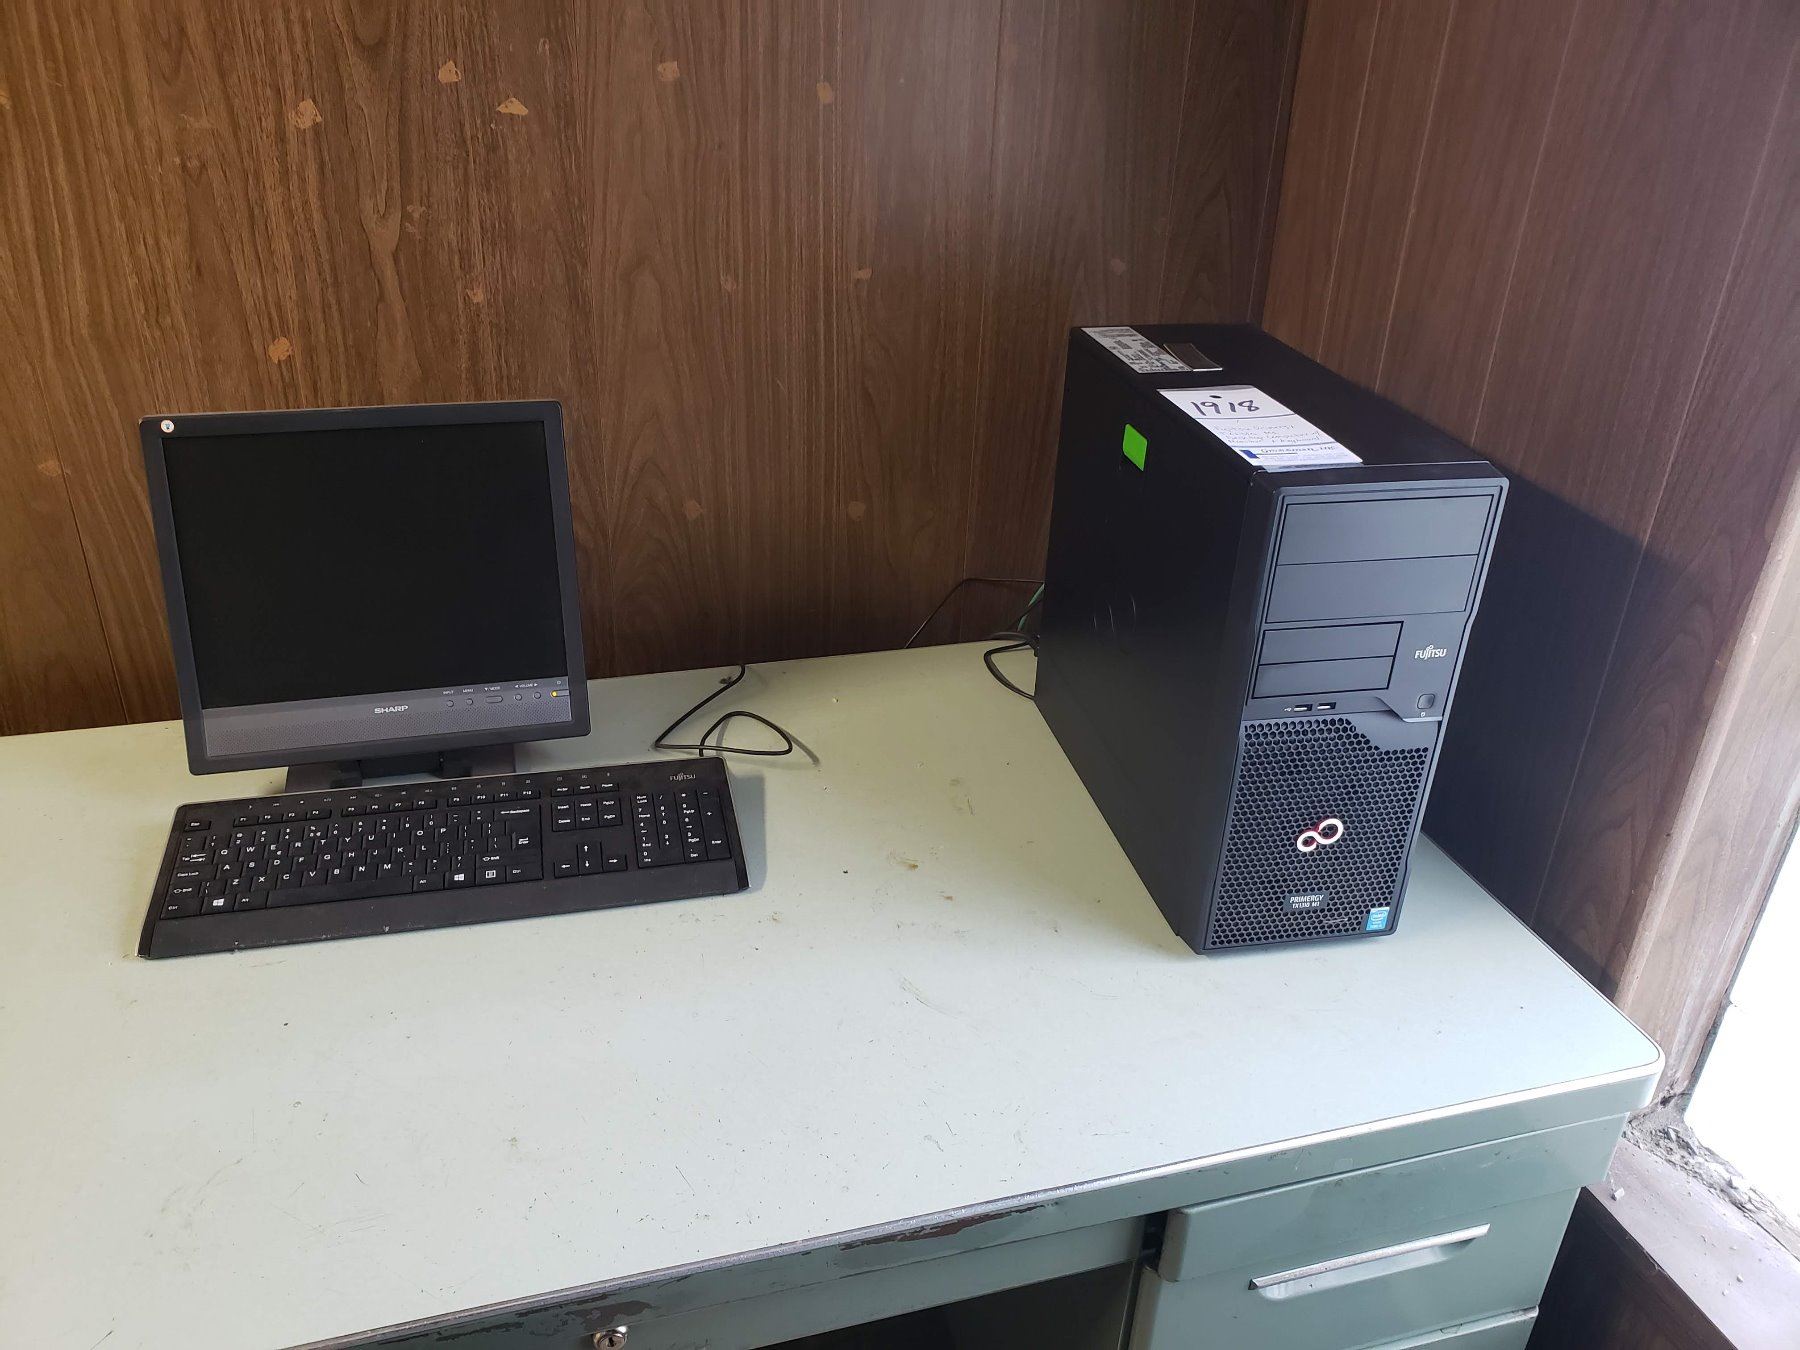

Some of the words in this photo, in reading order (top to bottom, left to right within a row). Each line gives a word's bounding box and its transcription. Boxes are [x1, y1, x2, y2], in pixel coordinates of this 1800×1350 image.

[1191, 400, 1260, 416] 1918
[1415, 645, 1446, 660] FUJITSU
[374, 705, 409, 714] SHARP
[670, 772, 696, 780] FUJITSU
[1290, 894, 1324, 903] PRIMERGY
